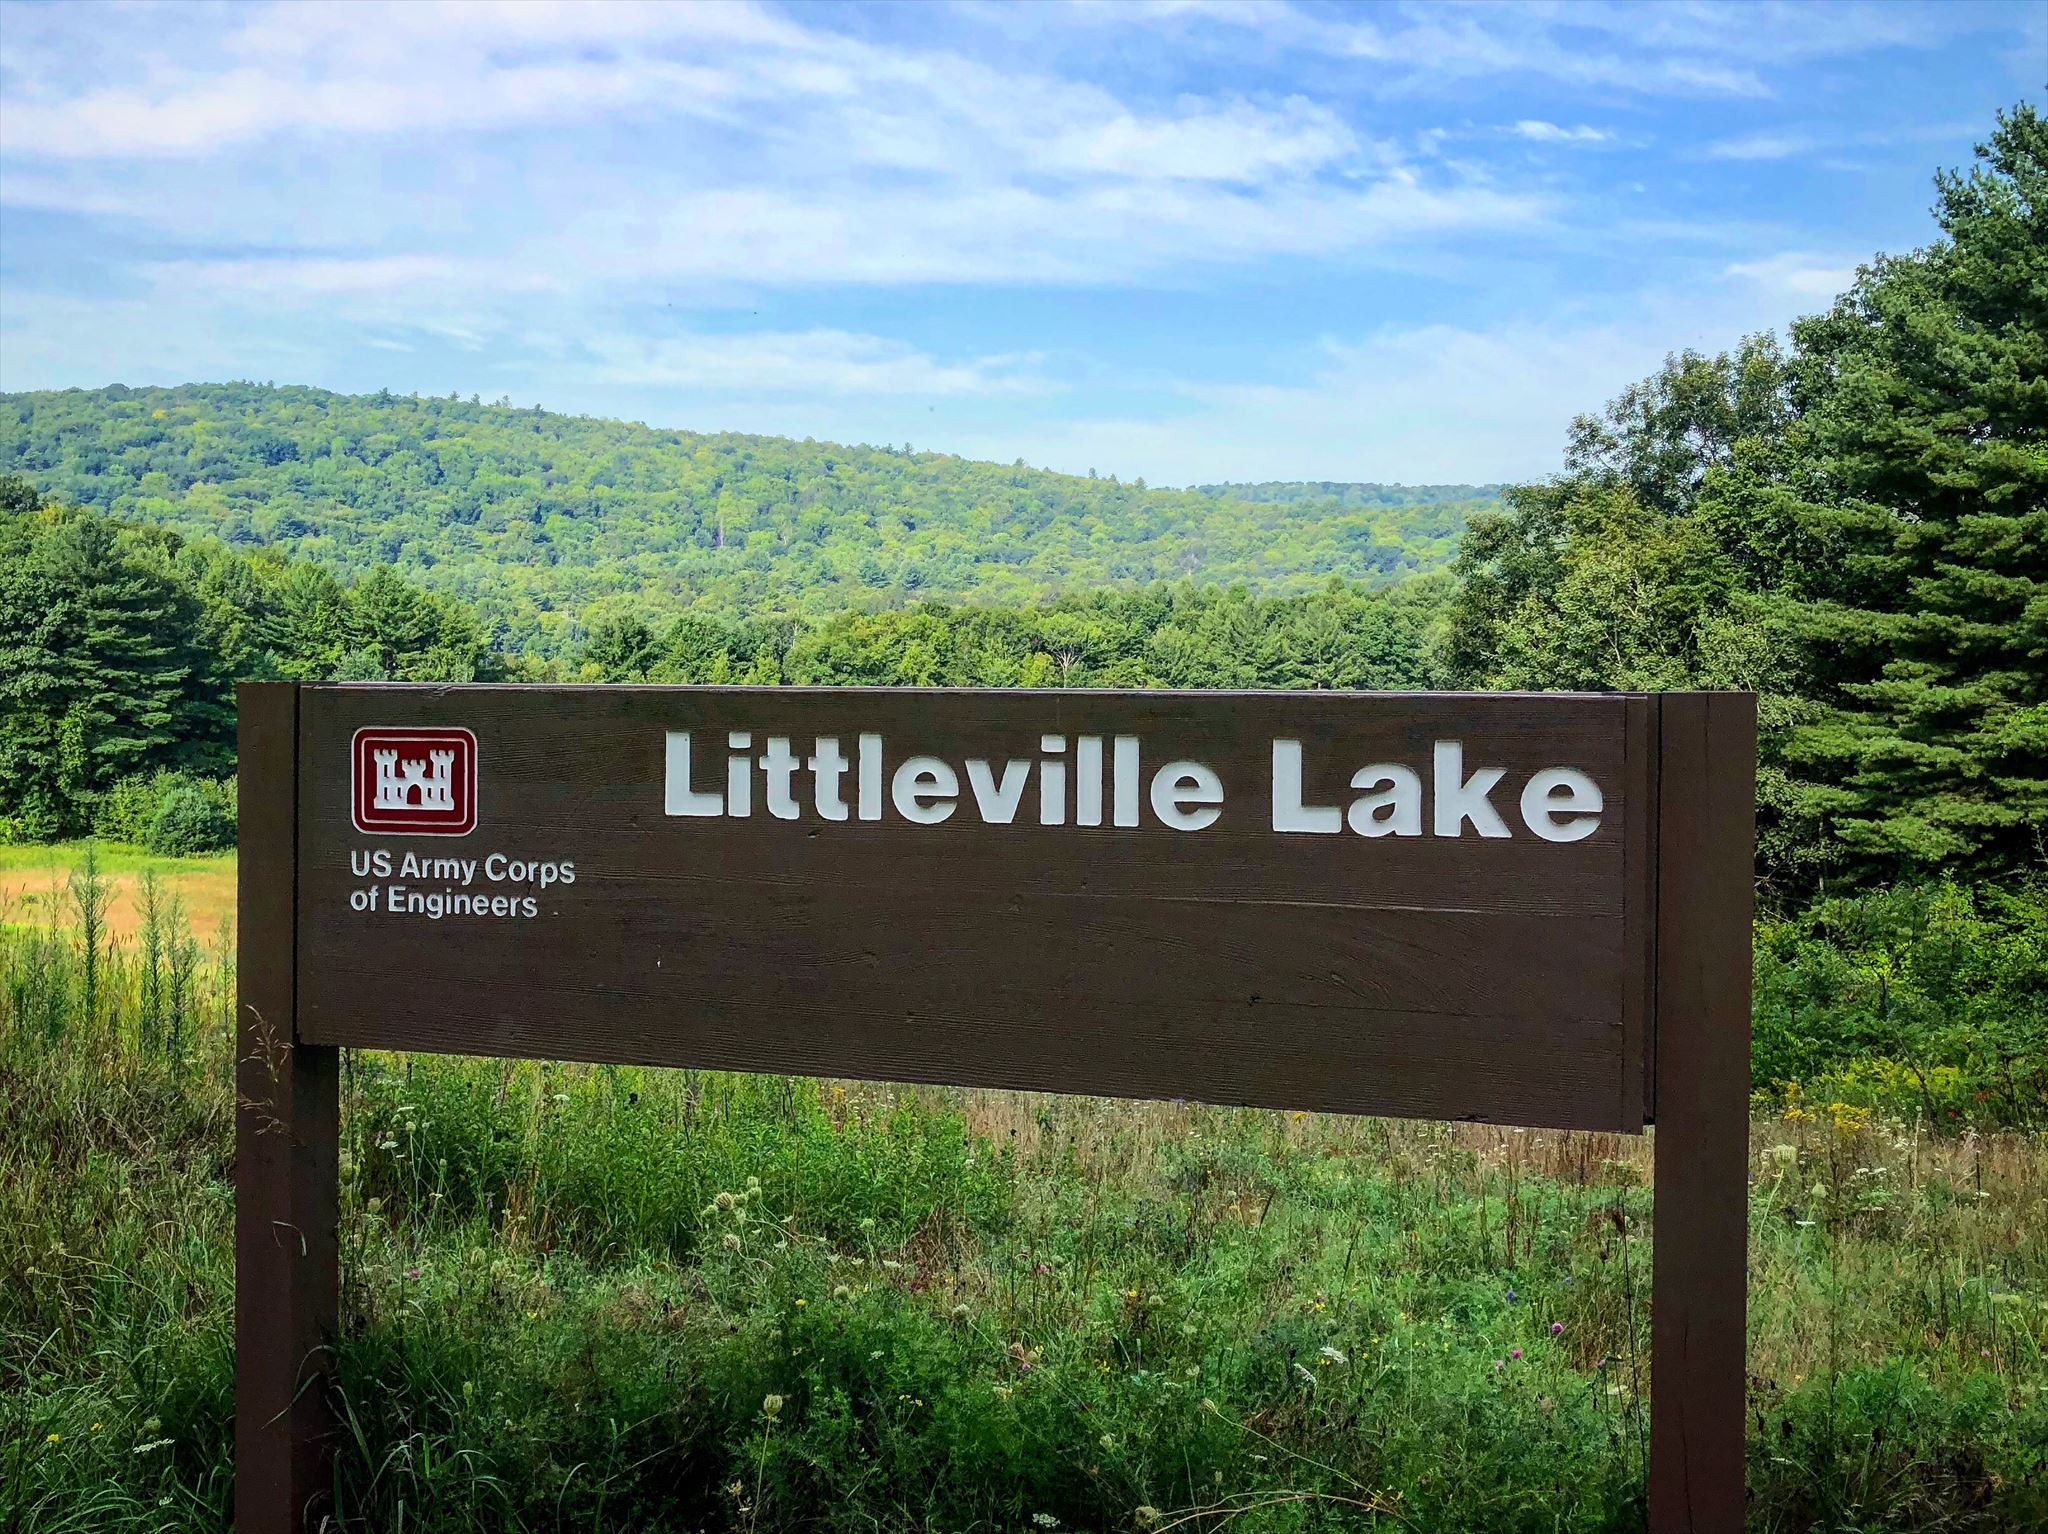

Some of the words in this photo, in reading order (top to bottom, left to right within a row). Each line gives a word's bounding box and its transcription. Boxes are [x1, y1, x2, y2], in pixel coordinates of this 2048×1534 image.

[664, 730, 1224, 831] Littleville
[1272, 739, 1604, 843] Lake
[350, 850, 392, 878] US
[400, 852, 477, 886] Army
[485, 853, 576, 889] Corps
[350, 885, 379, 912] of
[387, 885, 538, 920] Engineers
